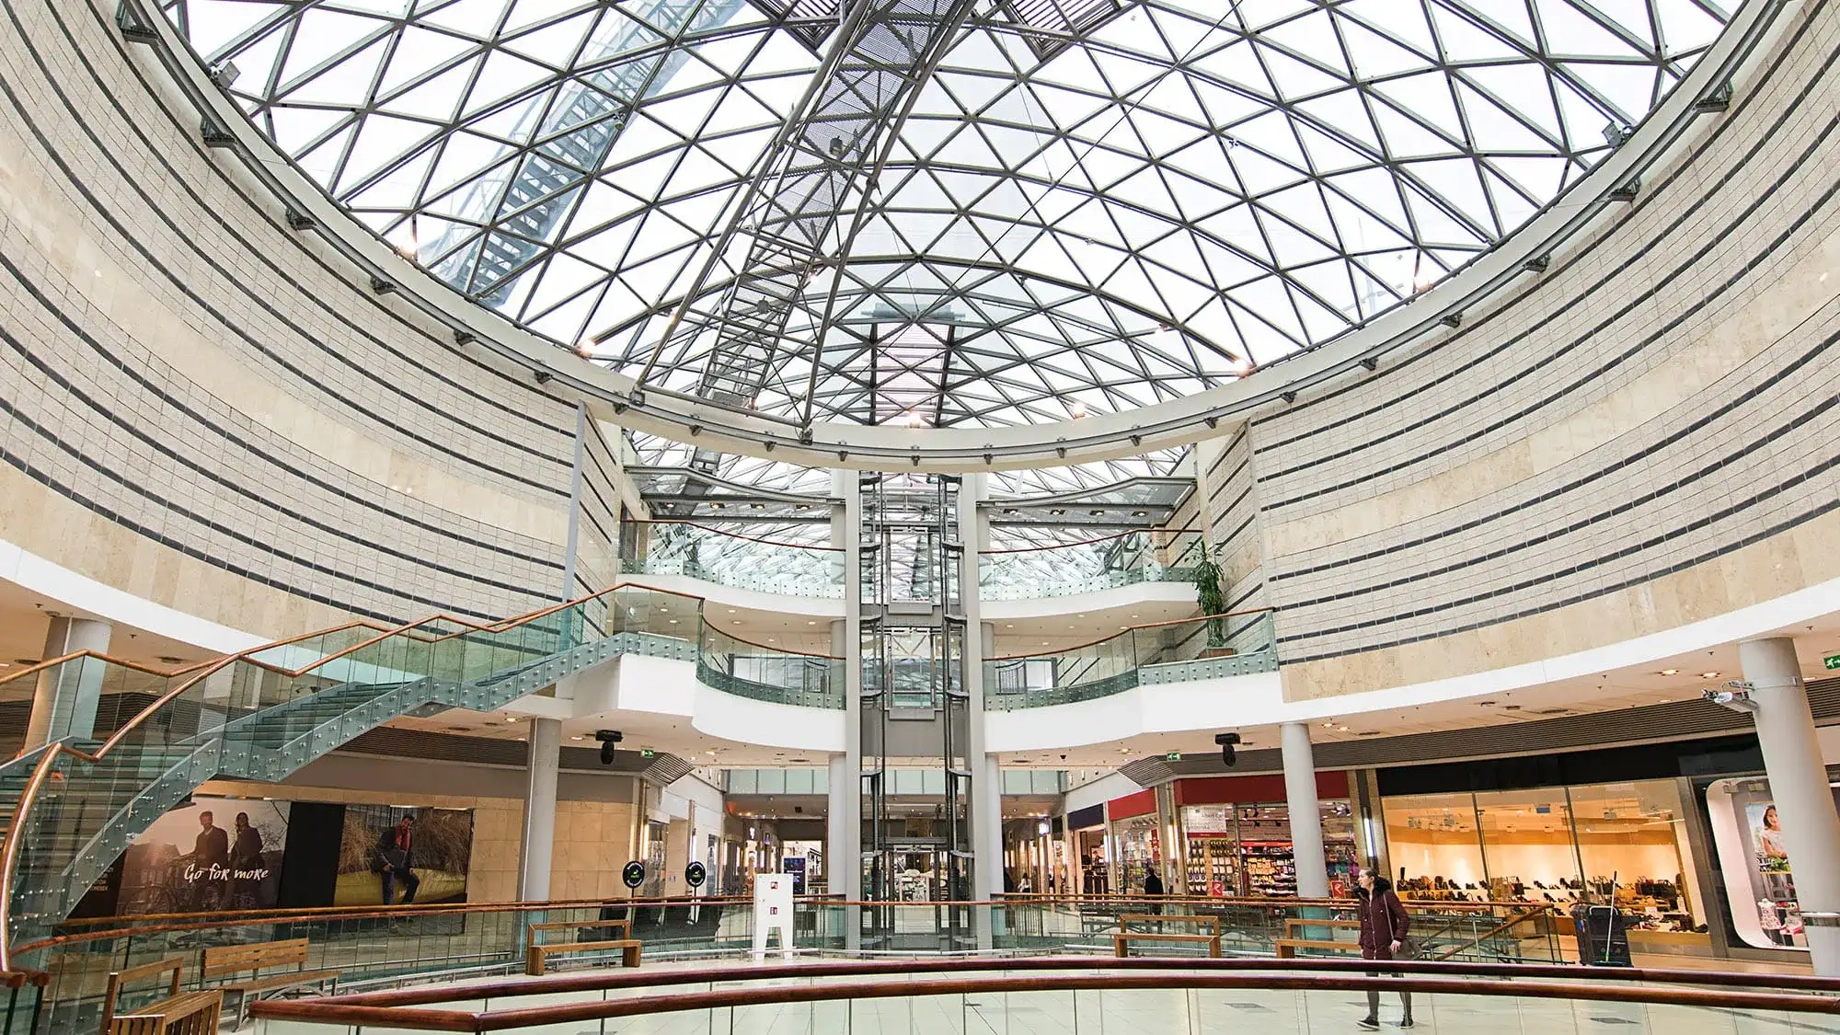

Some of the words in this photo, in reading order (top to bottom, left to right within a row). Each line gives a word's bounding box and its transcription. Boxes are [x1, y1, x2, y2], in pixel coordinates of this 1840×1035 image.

[184, 863, 204, 883] Go
[208, 863, 230, 881] for
[234, 868, 269, 881] more
